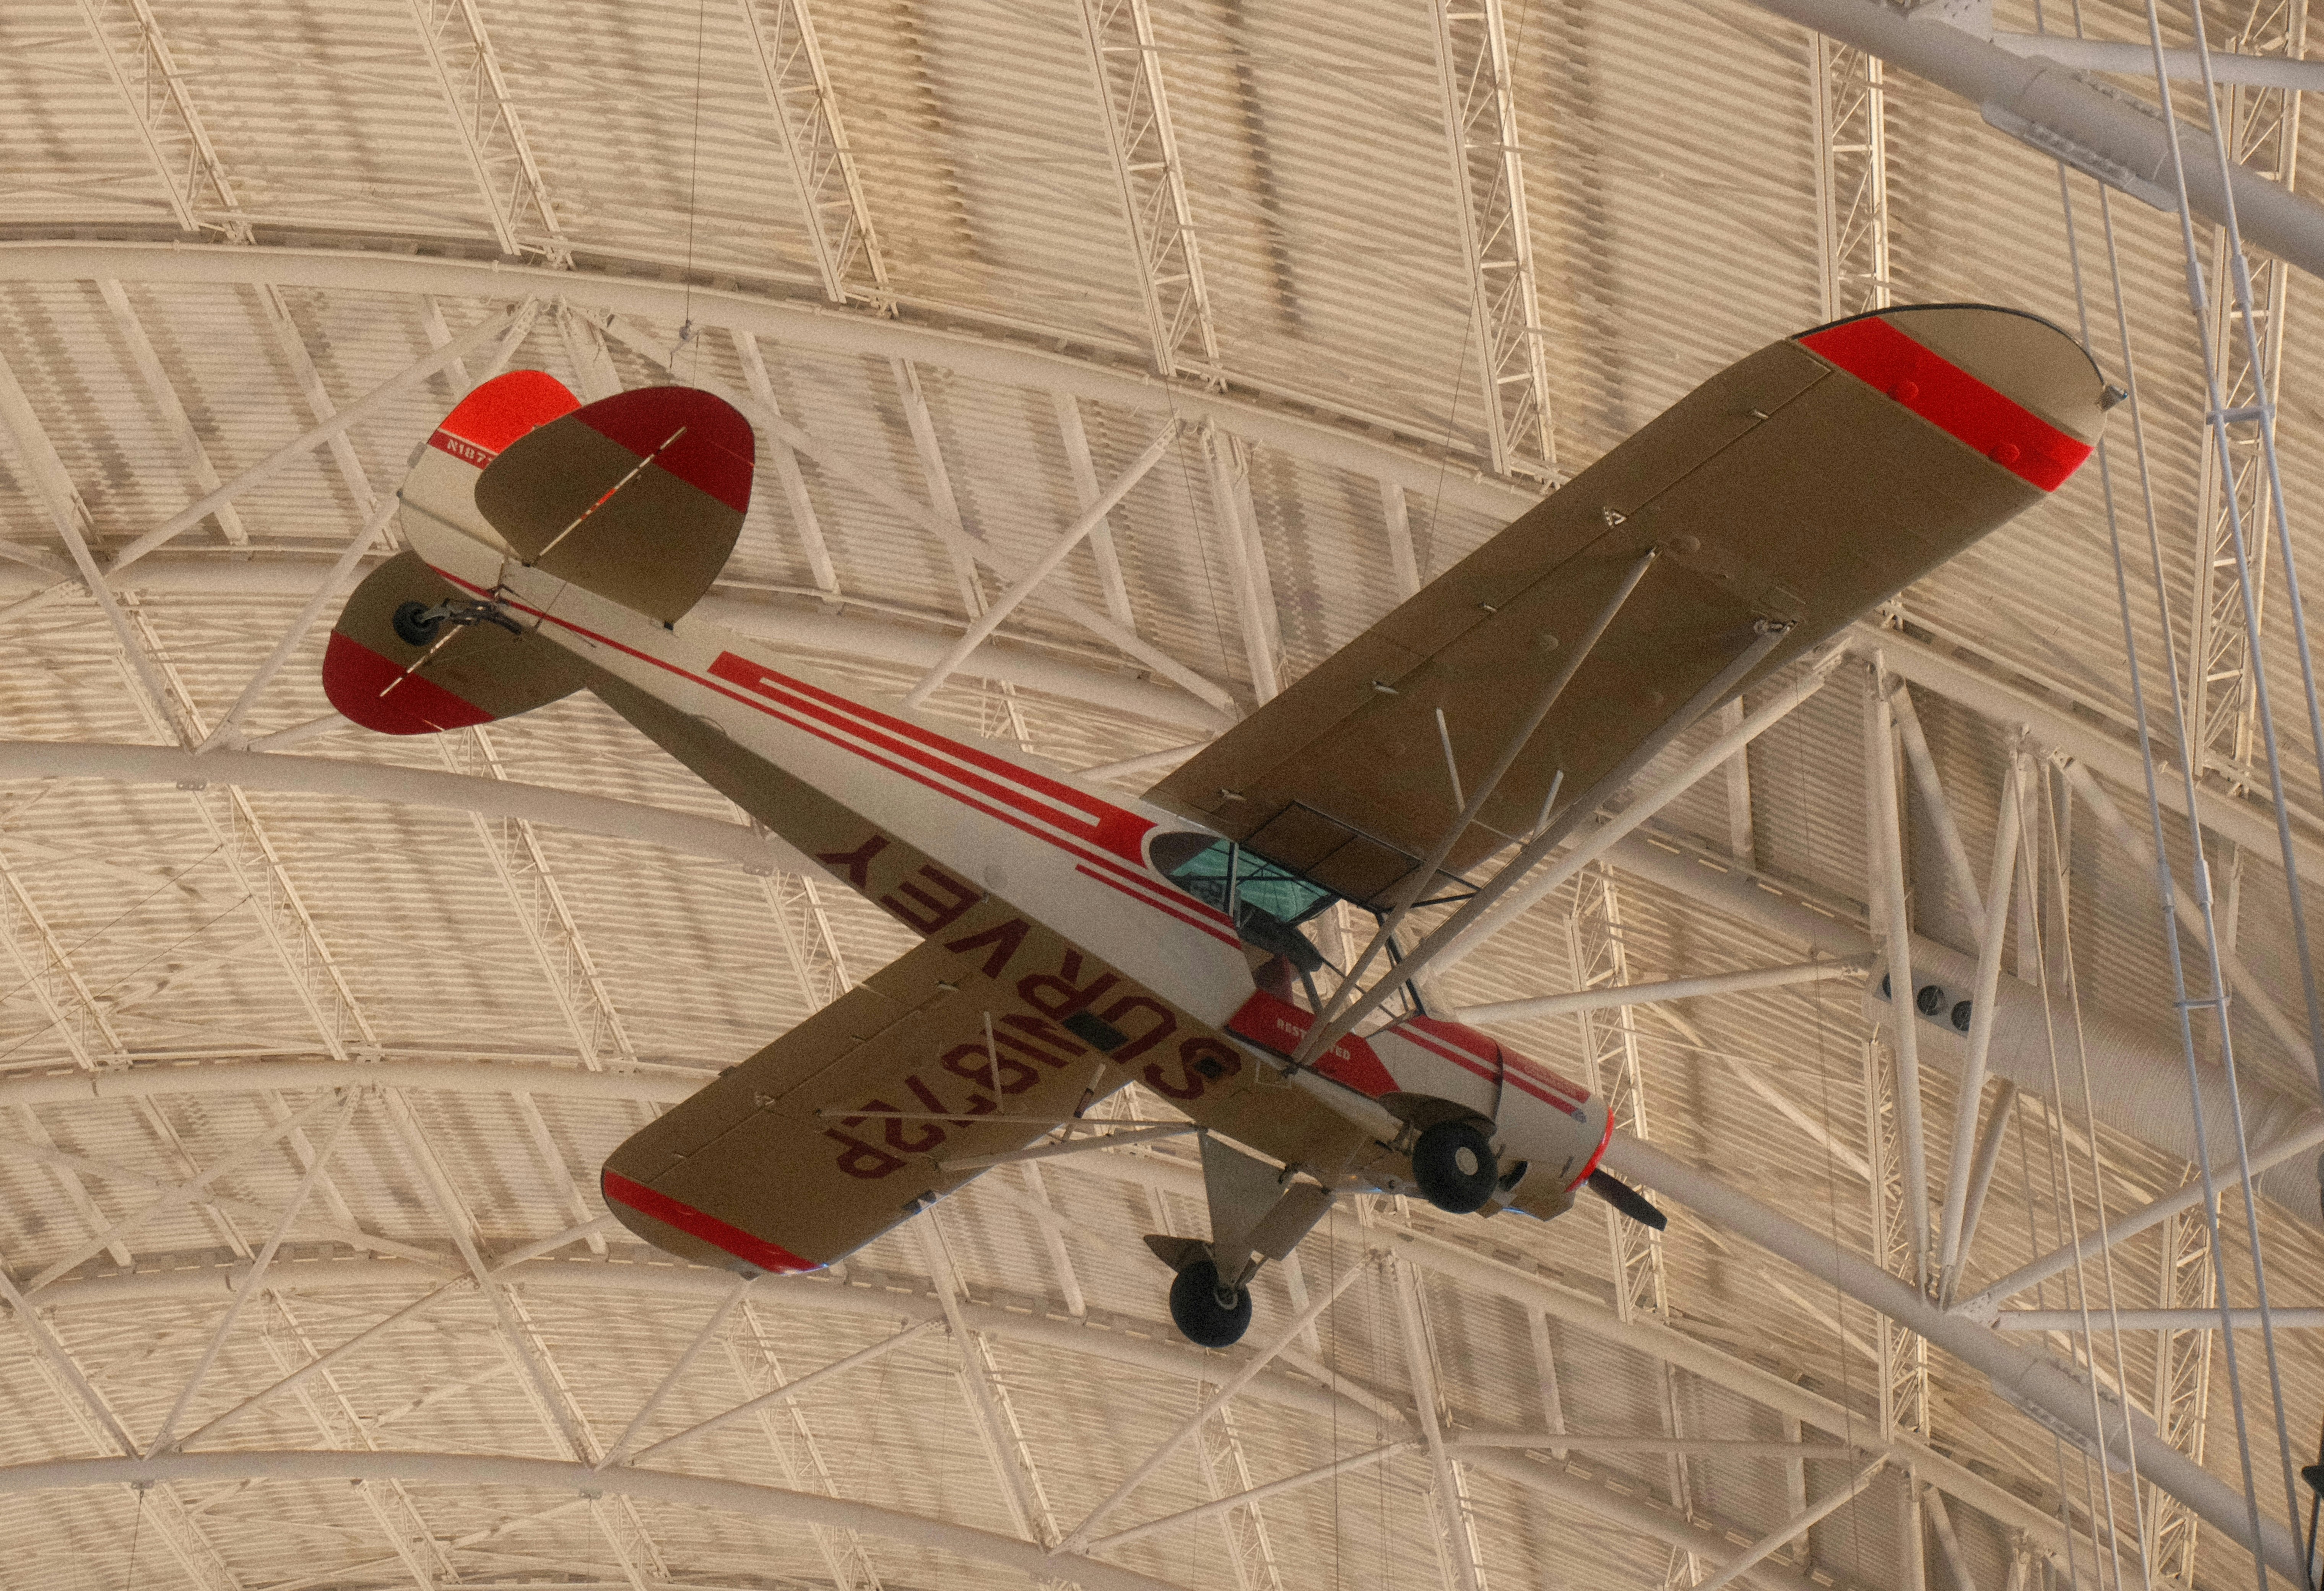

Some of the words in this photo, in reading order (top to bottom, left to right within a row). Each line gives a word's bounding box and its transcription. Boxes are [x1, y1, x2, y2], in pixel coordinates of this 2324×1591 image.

[447, 439, 492, 462] N187
[816, 834, 1242, 1100] SURVEY
[1277, 1017, 1351, 1061] RESTTED
